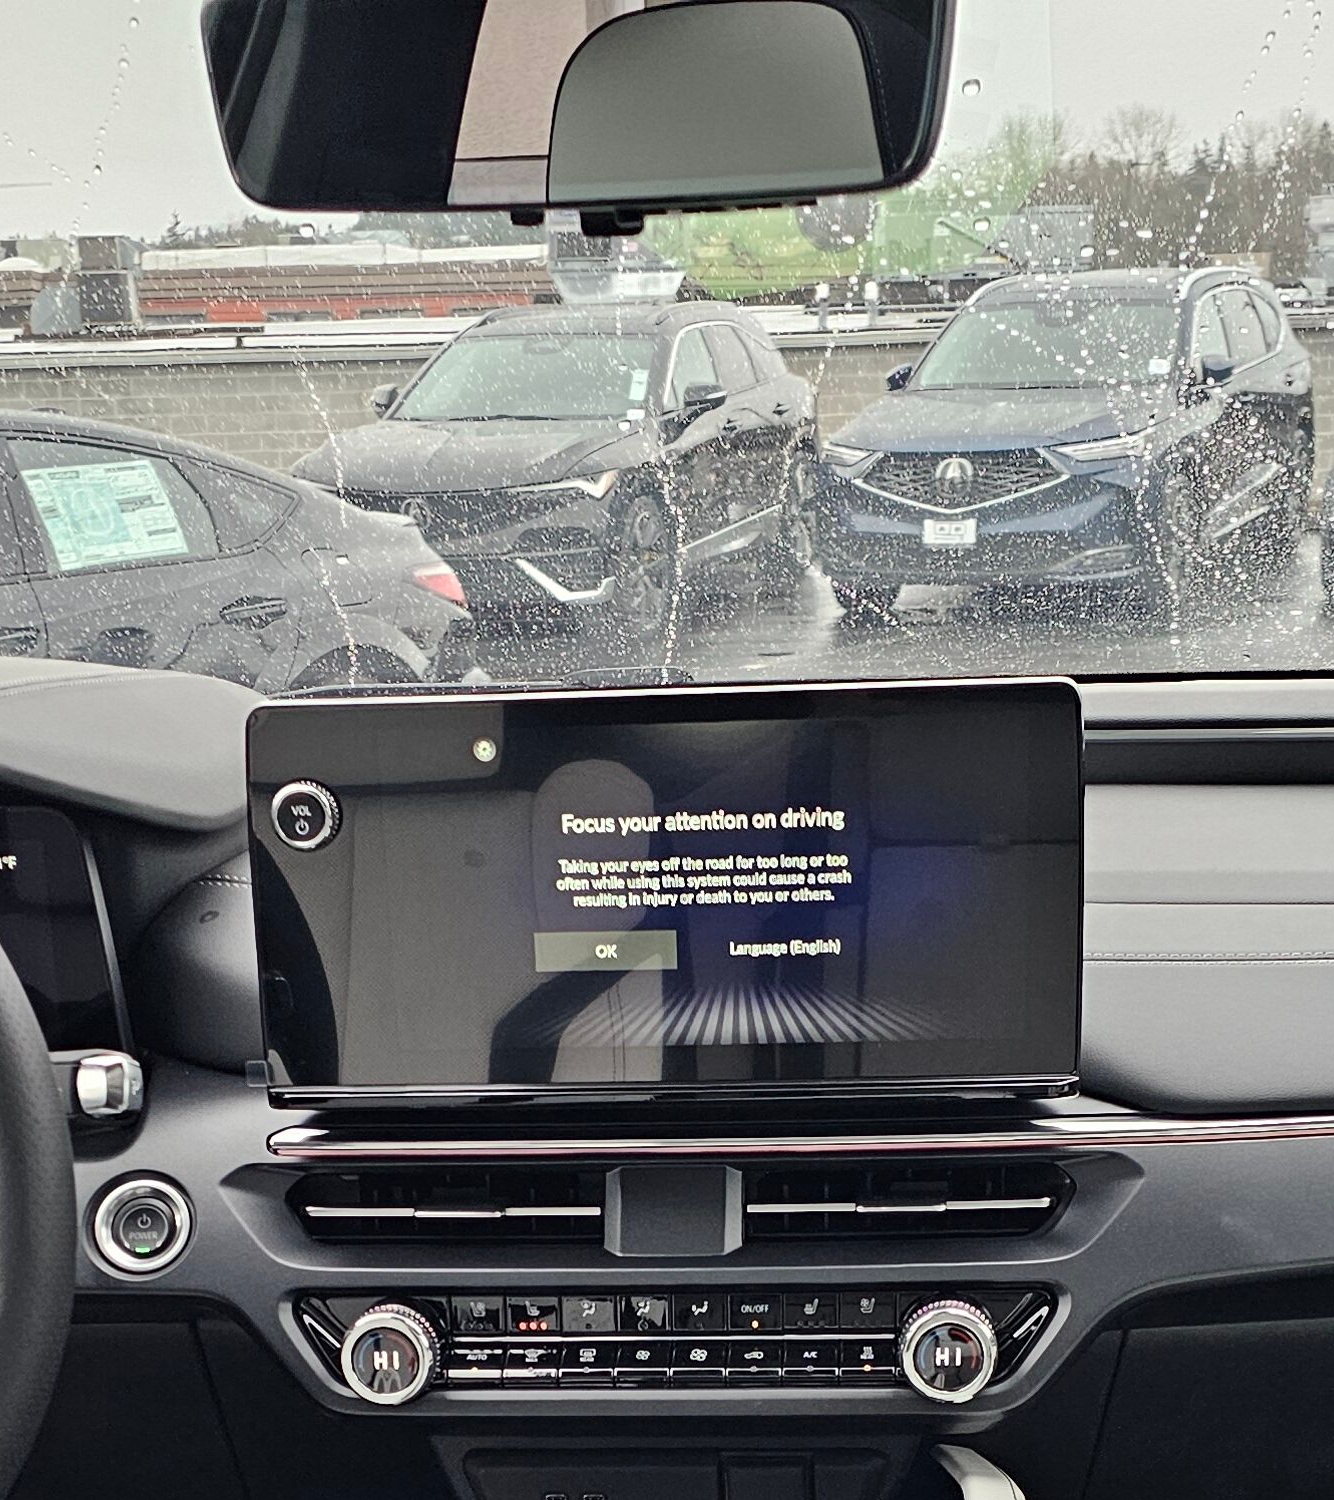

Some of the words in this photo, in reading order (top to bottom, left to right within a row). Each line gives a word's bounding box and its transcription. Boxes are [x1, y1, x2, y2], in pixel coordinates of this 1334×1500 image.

[291, 805, 312, 816] VOL
[561, 813, 616, 834] Focus
[618, 816, 661, 836] your
[665, 809, 748, 831] attention
[752, 813, 777, 829] on
[780, 806, 845, 831] driving
[557, 858, 599, 875] Taking
[600, 860, 629, 874] your
[630, 860, 659, 874] eyes
[661, 857, 680, 871] off
[681, 857, 703, 871] the
[705, 855, 734, 870] road
[735, 854, 755, 869] for
[756, 855, 779, 869] too
[780, 853, 808, 870] long
[809, 856, 824, 868] or
[826, 853, 848, 867] too
[556, 877, 589, 891] often
[591, 876, 625, 890] while
[627, 875, 660, 891] using
[662, 874, 685, 888] this
[687, 873, 731, 889] system
[733, 871, 767, 887] could
[769, 873, 805, 886] cause
[807, 873, 816, 885] a
[817, 869, 852, 884] crash
[573, 892, 627, 908] resulting
[628, 892, 641, 906] in
[642, 891, 678, 908] injury
[679, 893, 694, 905] or
[696, 889, 731, 904] death
[733, 890, 748, 904] to
[749, 891, 773, 905] you
[774, 890, 790, 903] or
[791, 887, 835, 902] others.
[595, 944, 618, 959] OK
[729, 941, 788, 958] Language
[790, 939, 841, 956] (English)
[129, 1230, 159, 1241] POWER
[740, 1304, 769, 1314] ON/OFF
[373, 1350, 400, 1371] HI
[803, 1351, 818, 1359] A/C
[934, 1347, 962, 1367] HI
